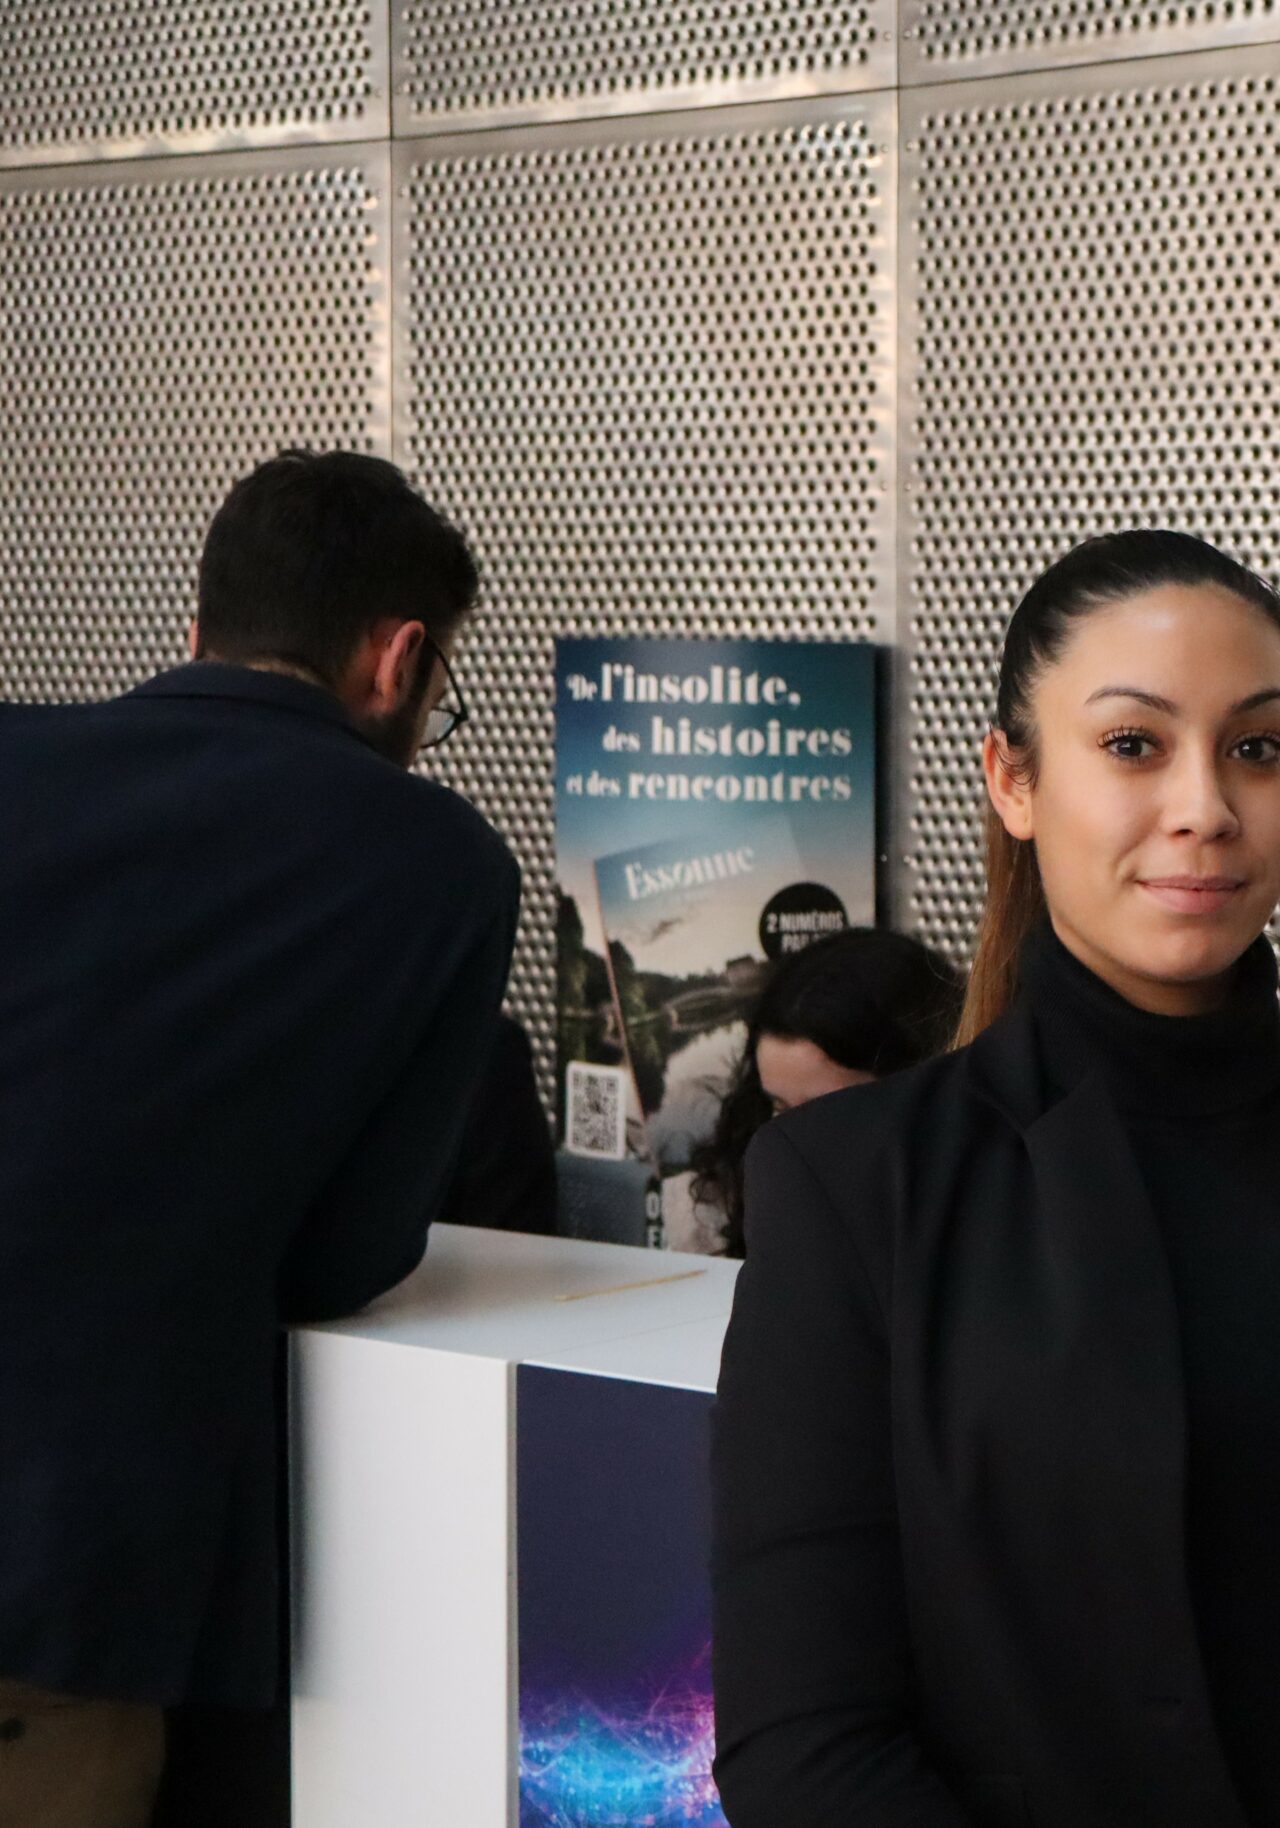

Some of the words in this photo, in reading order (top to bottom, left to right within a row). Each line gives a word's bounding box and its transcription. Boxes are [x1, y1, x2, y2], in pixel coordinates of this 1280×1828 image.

[566, 674, 598, 701] De
[602, 725, 641, 752] des
[652, 716, 852, 757] histoires
[566, 775, 582, 795] et
[587, 771, 620, 796] des
[629, 771, 852, 802] rencontres
[625, 847, 754, 900] Essonne
[766, 912, 778, 933] 2
